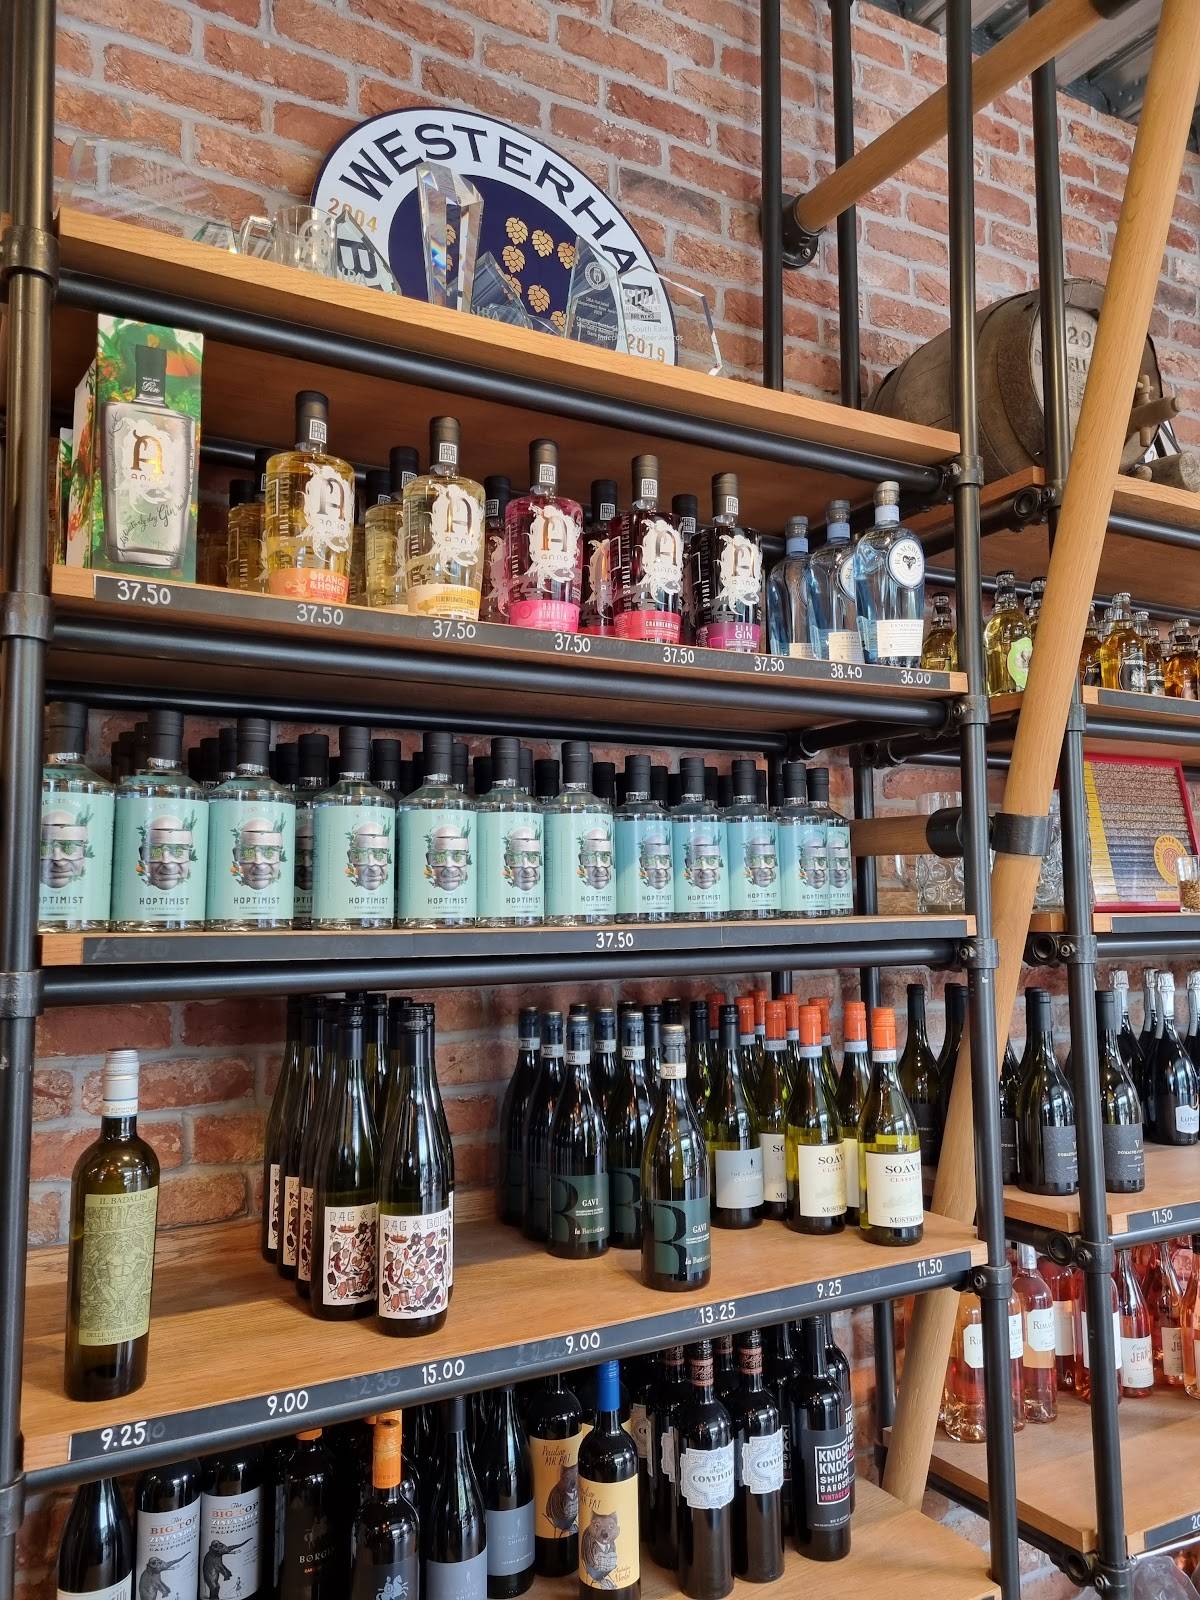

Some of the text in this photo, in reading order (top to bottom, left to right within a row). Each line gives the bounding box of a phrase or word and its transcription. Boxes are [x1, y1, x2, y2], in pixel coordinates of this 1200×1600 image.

[628, 333, 666, 364] 2019
[117, 580, 171, 605] 37.50
[296, 604, 344, 626] 37.50
[432, 619, 476, 639] 37.50
[734, 630, 753, 640] GIN
[554, 633, 591, 653] 37.50
[663, 647, 695, 665] 37.50
[754, 656, 785, 672] 37.50
[830, 663, 863, 679] 38.40
[900, 670, 931, 685] 36.00
[39, 896, 84, 905] PTIMIST
[596, 930, 635, 949] 37.50
[582, 1198, 599, 1207] GAVI
[384, 1219, 407, 1232] RAG
[1151, 1208, 1173, 1225] 11.50
[692, 1222, 707, 1234] GAVI
[917, 1259, 943, 1277] 11.50
[817, 1279, 842, 1298] 9.25
[699, 1302, 736, 1324] 13.25
[565, 1331, 600, 1354] 9.00
[421, 1359, 465, 1385] 15.00
[267, 1390, 309, 1416] 9.00
[101, 1420, 146, 1451] 9.25
[211, 1510, 233, 1518] BIG
[150, 1527, 174, 1535] BIG
